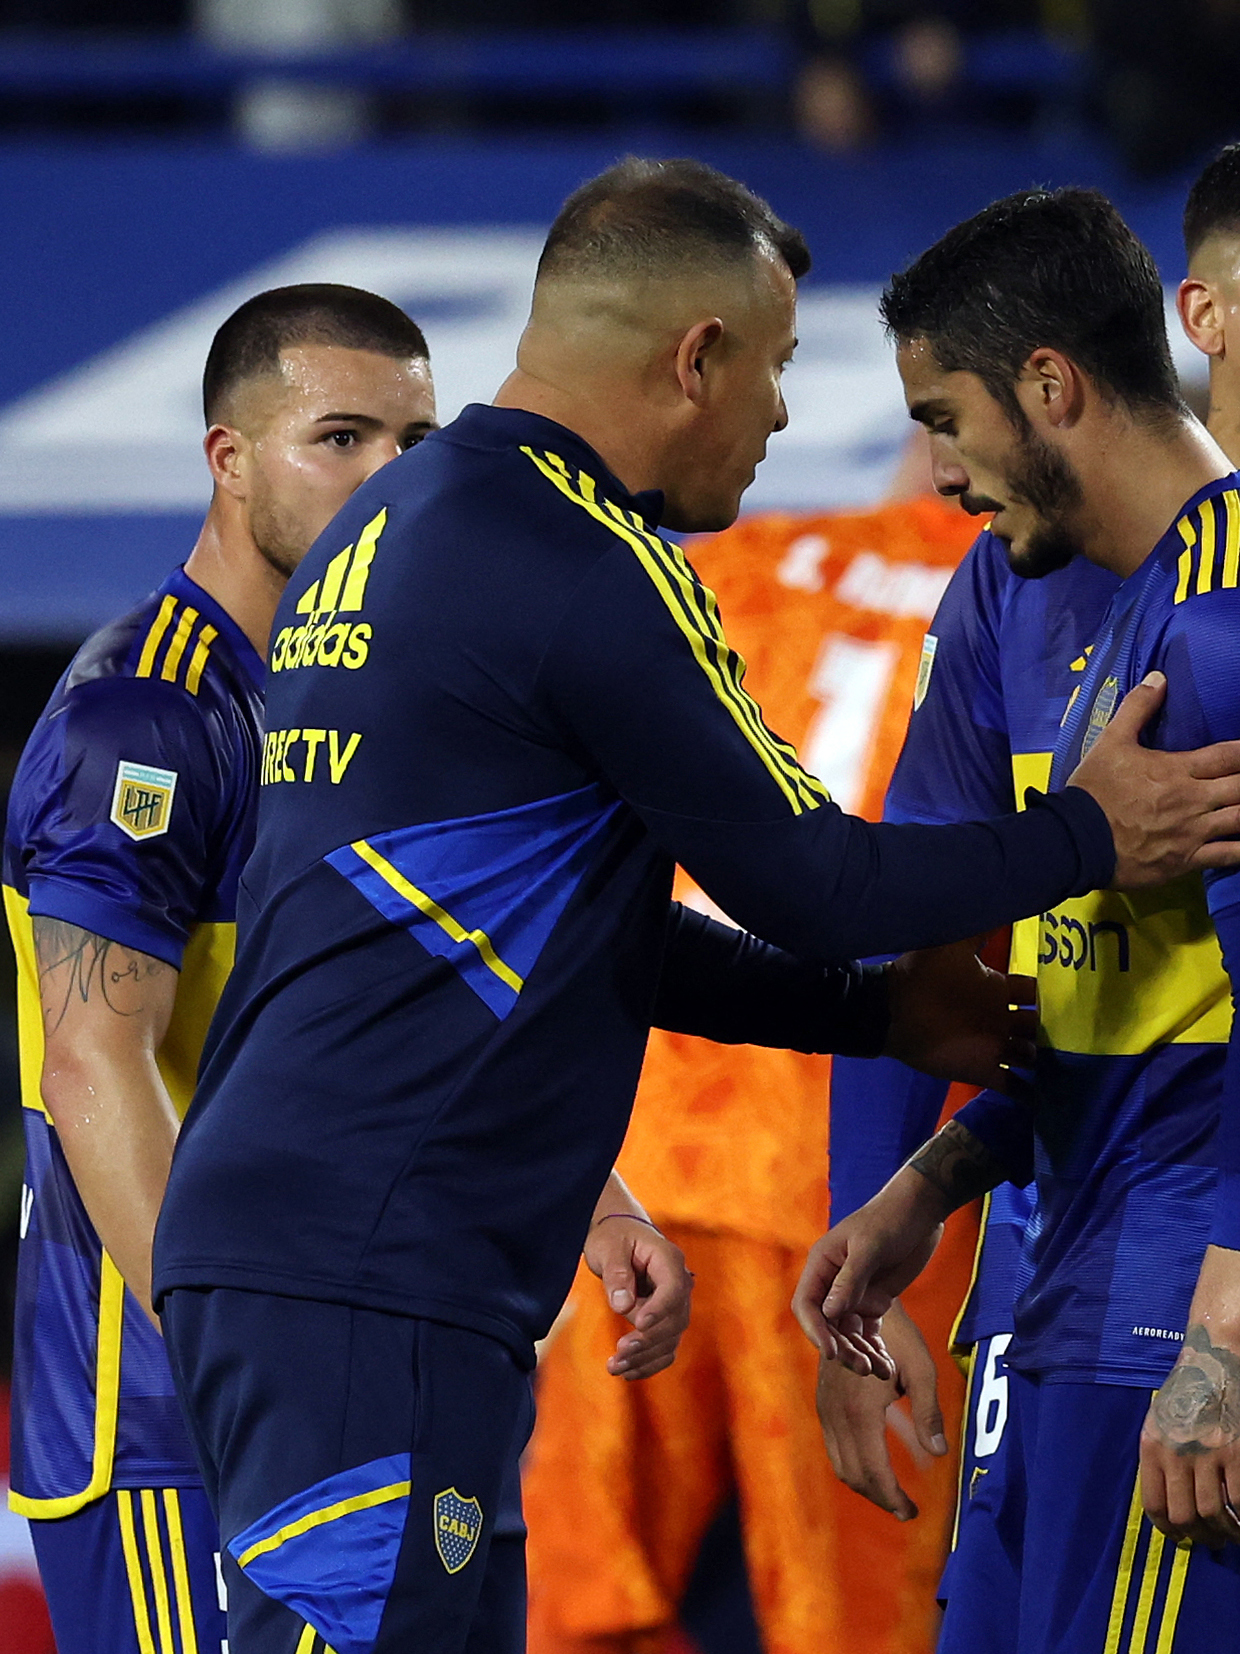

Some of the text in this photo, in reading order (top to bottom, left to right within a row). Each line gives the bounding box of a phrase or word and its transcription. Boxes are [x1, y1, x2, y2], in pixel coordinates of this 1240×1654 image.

[271, 610, 373, 673] adidas
[1039, 912, 1129, 972] sson
[1132, 1326, 1186, 1342] AEROREADY
[974, 1333, 1014, 1458] 6
[439, 1515, 475, 1542] CABJ
